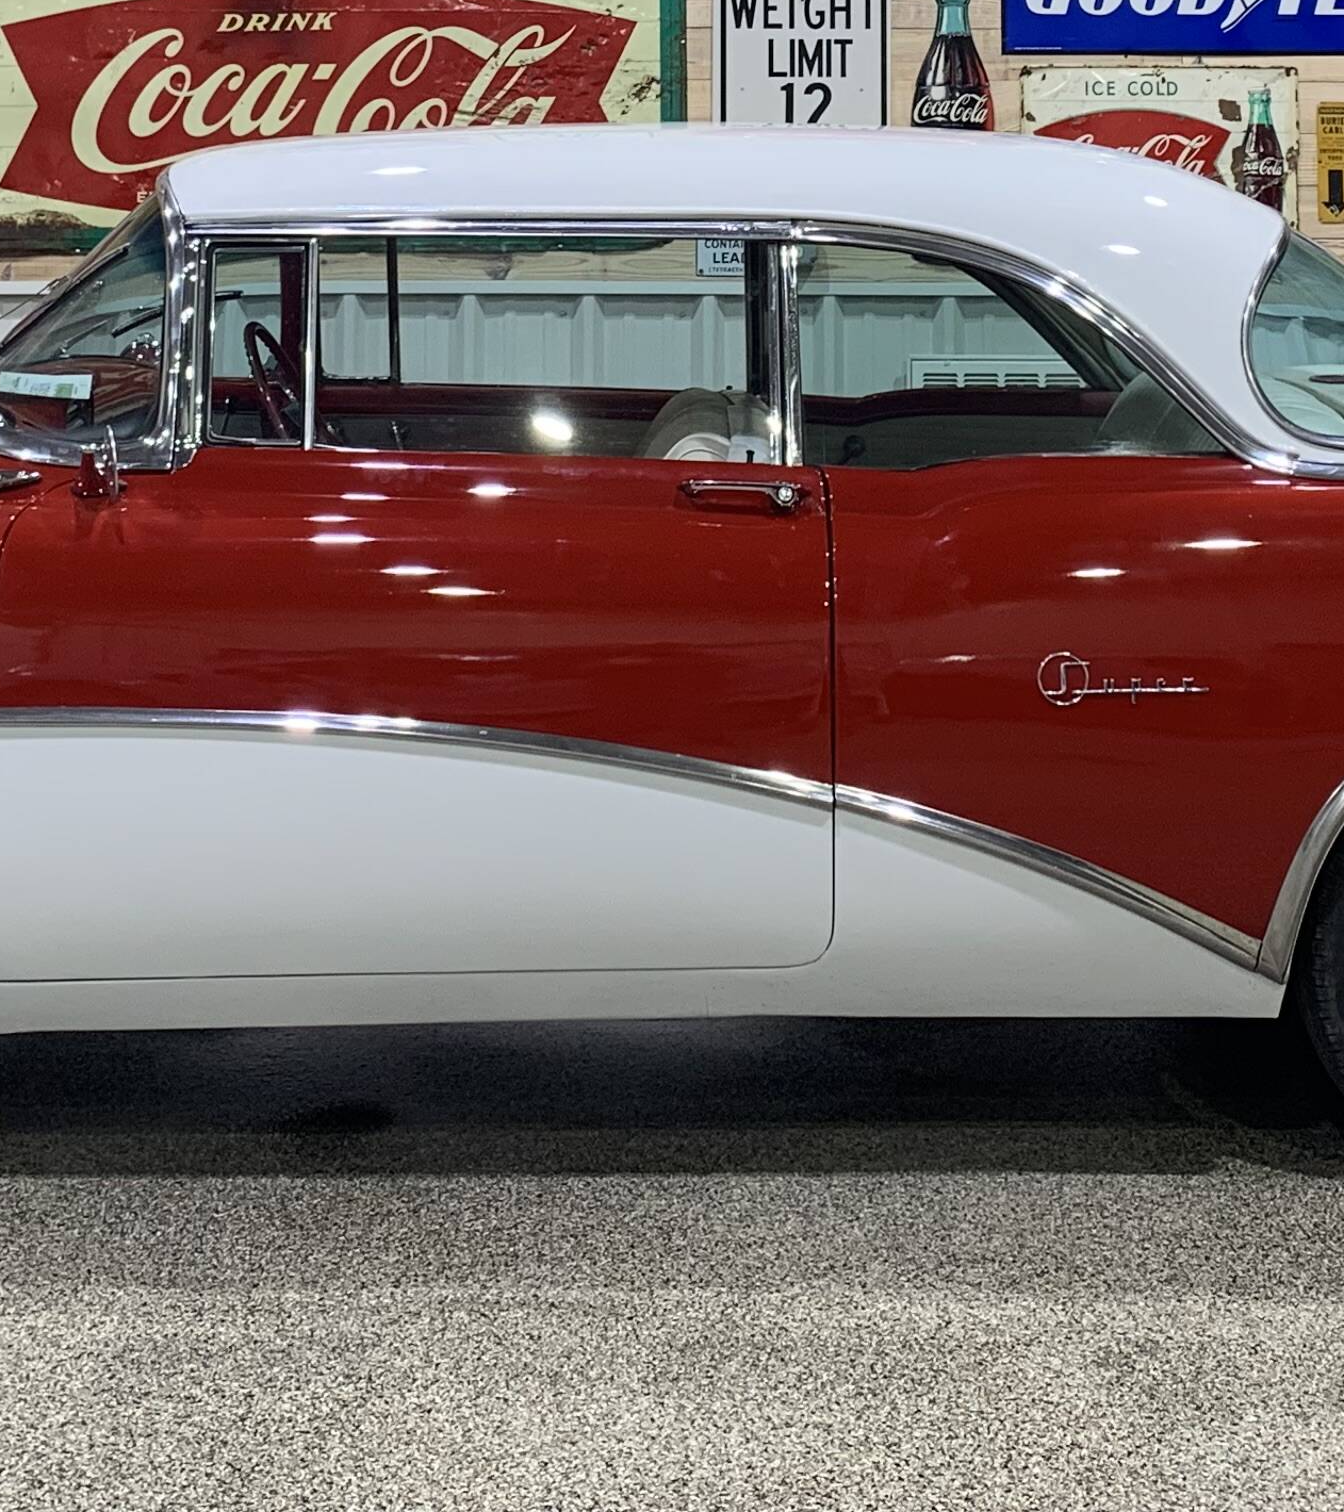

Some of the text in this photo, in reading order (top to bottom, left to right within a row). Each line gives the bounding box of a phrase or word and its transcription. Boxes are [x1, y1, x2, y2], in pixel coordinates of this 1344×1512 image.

[216, 11, 336, 33] DRINK
[769, 38, 853, 78] LIMIT
[780, 83, 832, 125] 12
[1085, 80, 1178, 97] ICE COLD
[914, 94, 988, 125] Coca-Cola
